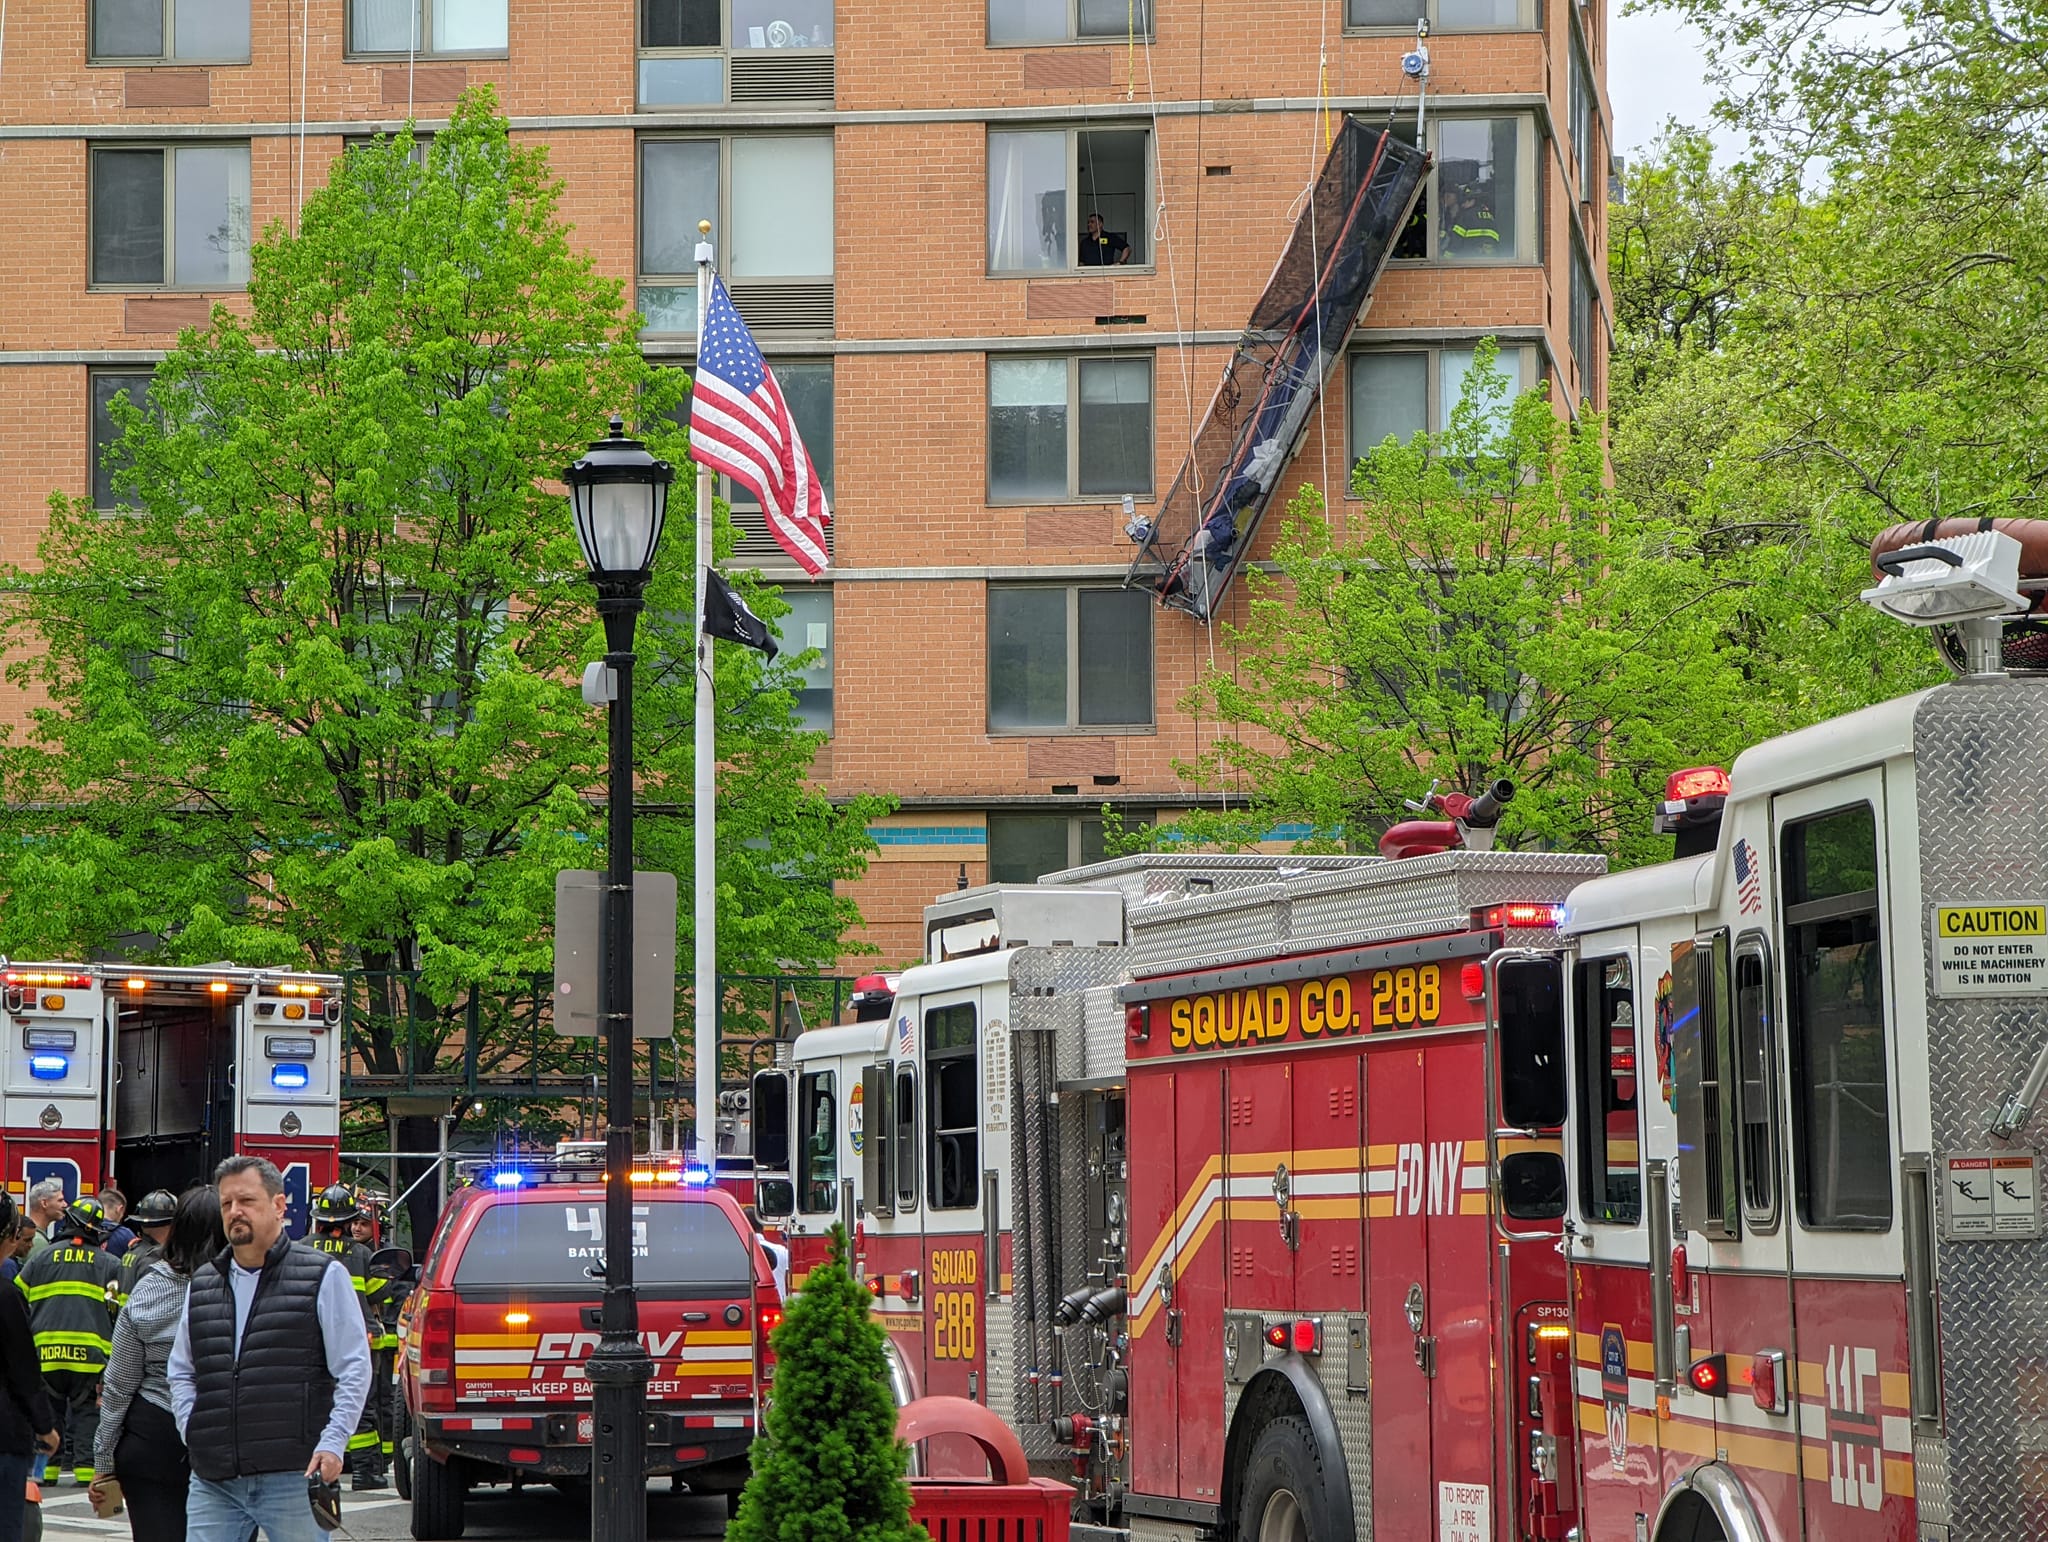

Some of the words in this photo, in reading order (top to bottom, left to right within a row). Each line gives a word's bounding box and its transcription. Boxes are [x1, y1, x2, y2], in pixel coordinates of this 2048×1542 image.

[1947, 910, 2038, 932] CAUTION
[1954, 946, 1969, 956] DO
[1972, 945, 1994, 955] NOT
[1998, 944, 2033, 955] ENTER
[1942, 960, 1977, 970] WHILE
[1980, 958, 2046, 970] MACHINERY
[1958, 975, 1969, 984] IS
[1973, 974, 1984, 984] IN
[1988, 973, 2031, 984] MOTION
[1170, 989, 1290, 1049] SQUAD
[1300, 976, 1360, 1035] CO.
[1372, 964, 1440, 1027] 288
[1396, 1141, 1463, 1216] FDNY
[931, 1249, 977, 1285] SQUAD
[934, 1291, 975, 1360] 288
[41, 1346, 87, 1361] MORALES
[465, 1382, 494, 1390] GM11011
[465, 1390, 531, 1398] SIERRA
[532, 1382, 568, 1395] KEEP
[573, 1382, 593, 1395] BA
[646, 1380, 680, 1394] FEET
[1444, 1486, 1454, 1503] TO
[1456, 1487, 1485, 1505] REPORT
[1453, 1508, 1459, 1526] A
[1461, 1510, 1476, 1527] FIRE
